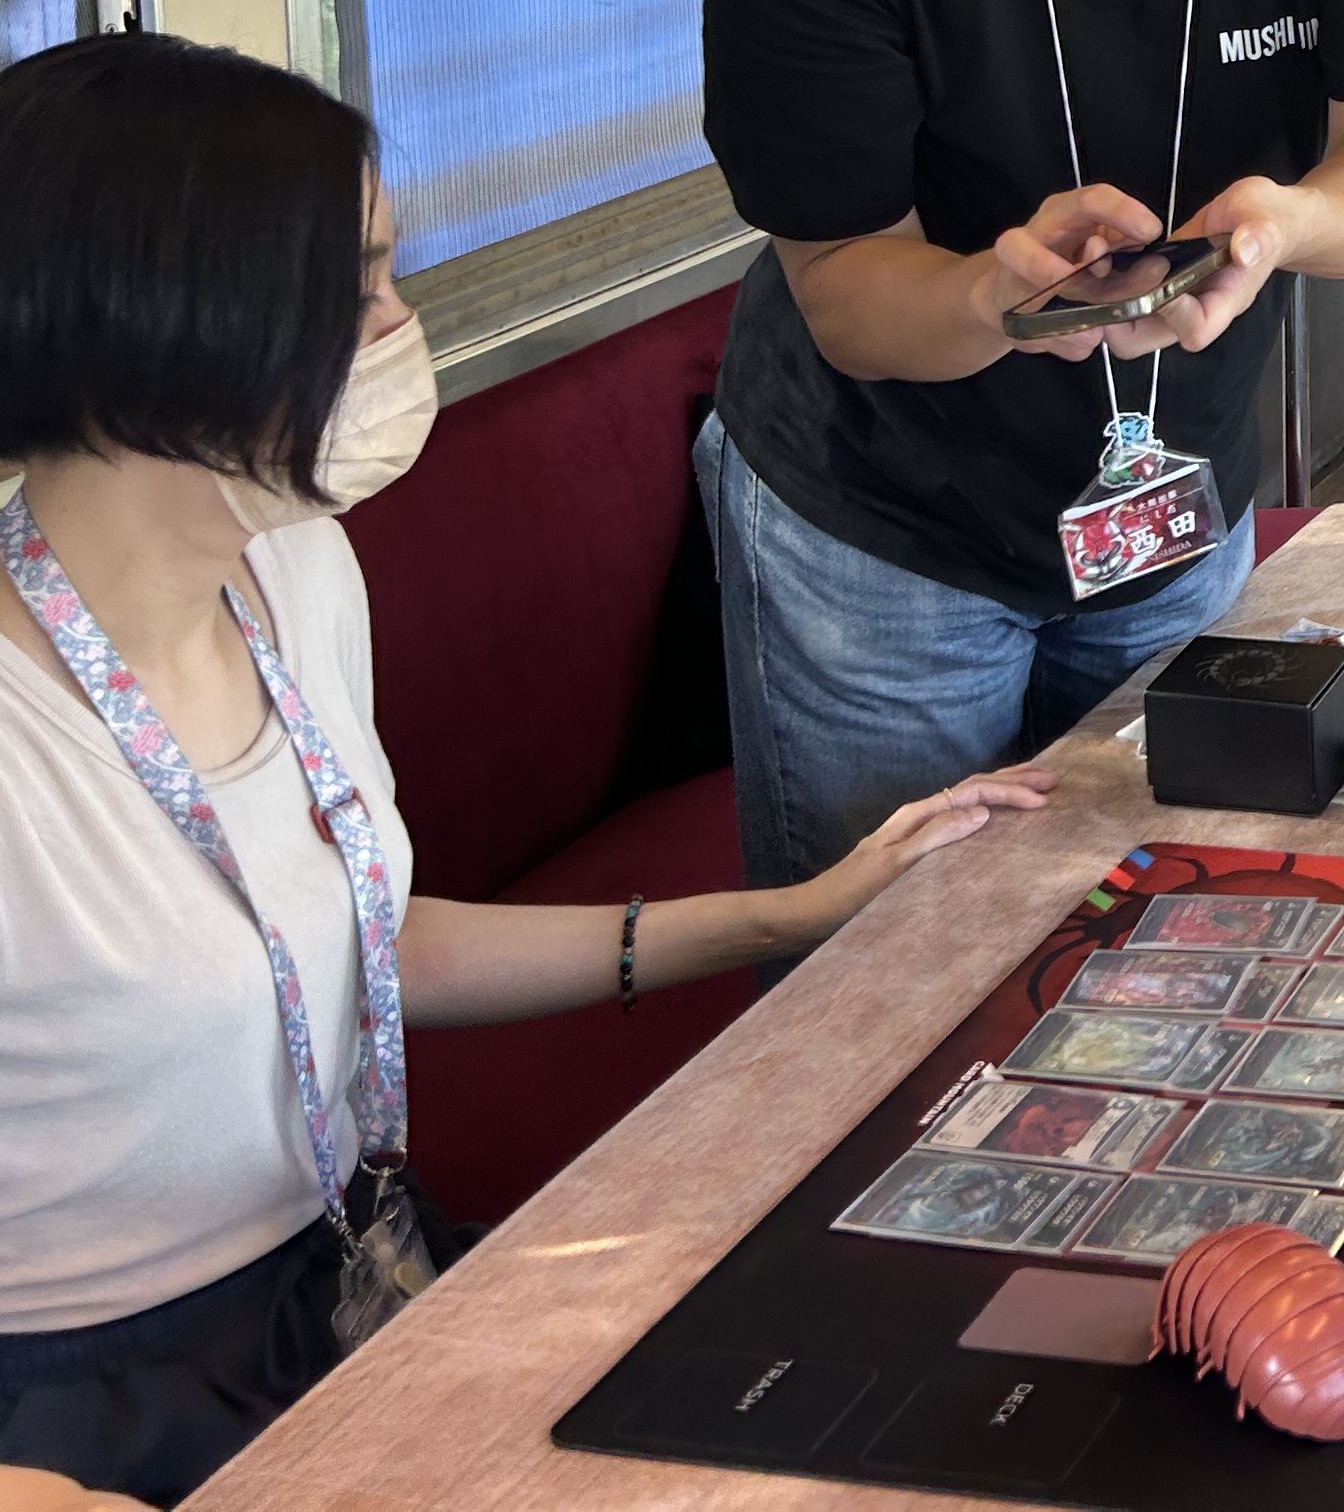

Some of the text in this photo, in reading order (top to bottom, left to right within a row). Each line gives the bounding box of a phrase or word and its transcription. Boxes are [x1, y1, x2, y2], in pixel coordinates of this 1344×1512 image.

[1219, 15, 1296, 64] MUSHI
[1128, 510, 1196, 555] 西田
[733, 1357, 796, 1413] TRASH
[989, 1382, 1035, 1427] DECK
